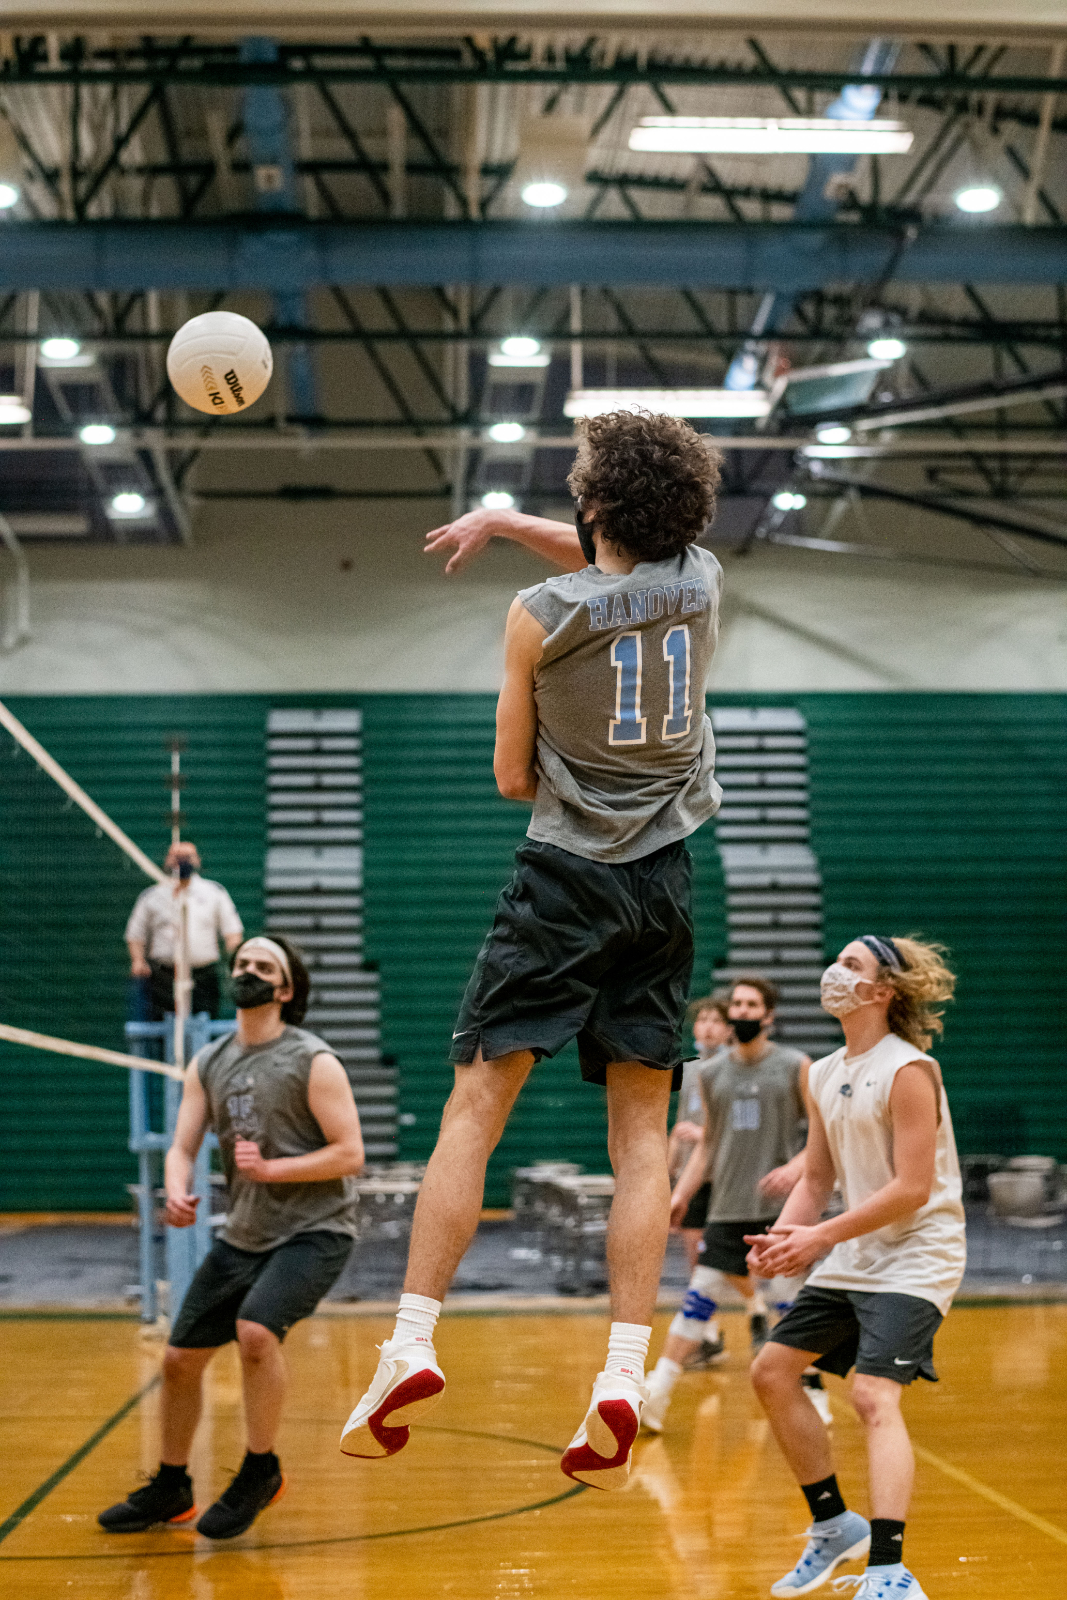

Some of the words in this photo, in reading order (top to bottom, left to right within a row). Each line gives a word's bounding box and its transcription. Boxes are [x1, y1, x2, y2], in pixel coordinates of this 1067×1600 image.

[224, 369, 246, 407] Wilson
[586, 577, 707, 631] HANOVER
[608, 624, 692, 746] 11
